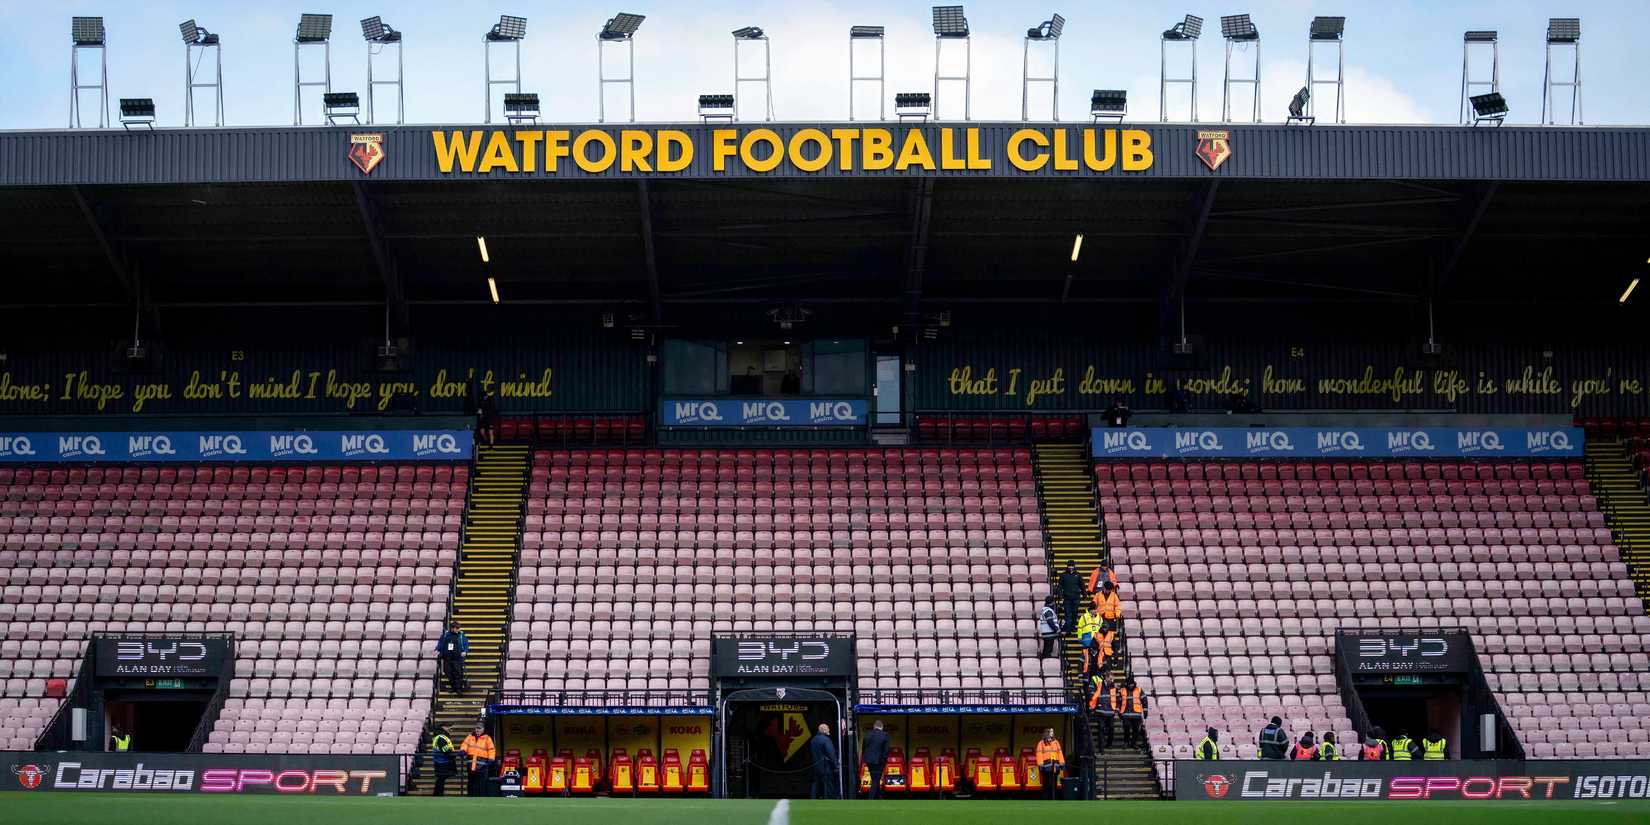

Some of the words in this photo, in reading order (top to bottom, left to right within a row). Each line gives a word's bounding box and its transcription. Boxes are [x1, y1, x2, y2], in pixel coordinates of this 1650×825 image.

[432, 129, 694, 172] WATFORD
[713, 128, 992, 171] FOOTBALL
[1007, 128, 1154, 171] CLUB
[232, 351, 245, 361] E3
[1291, 347, 1304, 358] E4
[60, 373, 77, 400] I
[77, 370, 124, 411] hope
[133, 381, 172, 413] you
[184, 369, 241, 399] don't
[249, 369, 301, 398] mind
[304, 371, 321, 399] I
[325, 368, 372, 408] hope
[500, 367, 552, 397] mind
[947, 365, 998, 395] that
[1003, 367, 1021, 396] I
[1026, 368, 1065, 406] put
[1078, 365, 1137, 395] down
[1145, 373, 1166, 395] in
[1262, 365, 1305, 395] how
[1318, 365, 1424, 403] wonderful
[1432, 367, 1469, 403] life
[1477, 371, 1498, 395] is
[1505, 365, 1562, 395] while
[676, 402, 723, 423] MrQ
[743, 402, 790, 423] MrQ
[810, 401, 857, 423] MrQ
[59, 436, 106, 455] MrQ
[129, 435, 176, 455] MrQ
[200, 435, 247, 455] MrQ
[270, 435, 318, 455] MrQ
[341, 434, 389, 454] MrQ
[413, 434, 461, 454] MrQ
[1103, 431, 1152, 450] MrQ
[1175, 431, 1223, 450] MrQ
[1246, 431, 1294, 450] MrQ
[1317, 431, 1364, 450] MrQ
[1388, 431, 1435, 450] MrQ
[1457, 431, 1505, 450] MrQ
[1527, 431, 1574, 450] MrQ
[116, 642, 207, 660] BYD
[737, 641, 830, 660] BYD
[1359, 638, 1448, 657] BYD
[116, 665, 148, 673] ALAN
[150, 665, 172, 673] DAY
[737, 665, 770, 673] ALAN
[772, 665, 794, 673] DAY
[1359, 662, 1390, 670] ALAN
[1392, 662, 1414, 670] DAY
[669, 726, 703, 735] KOKA
[53, 761, 195, 791] Carabao
[200, 768, 388, 794] SPORT
[1240, 770, 1382, 798] Carabao
[1388, 776, 1570, 800] SPORT
[1574, 775, 1650, 798] ISOTO
